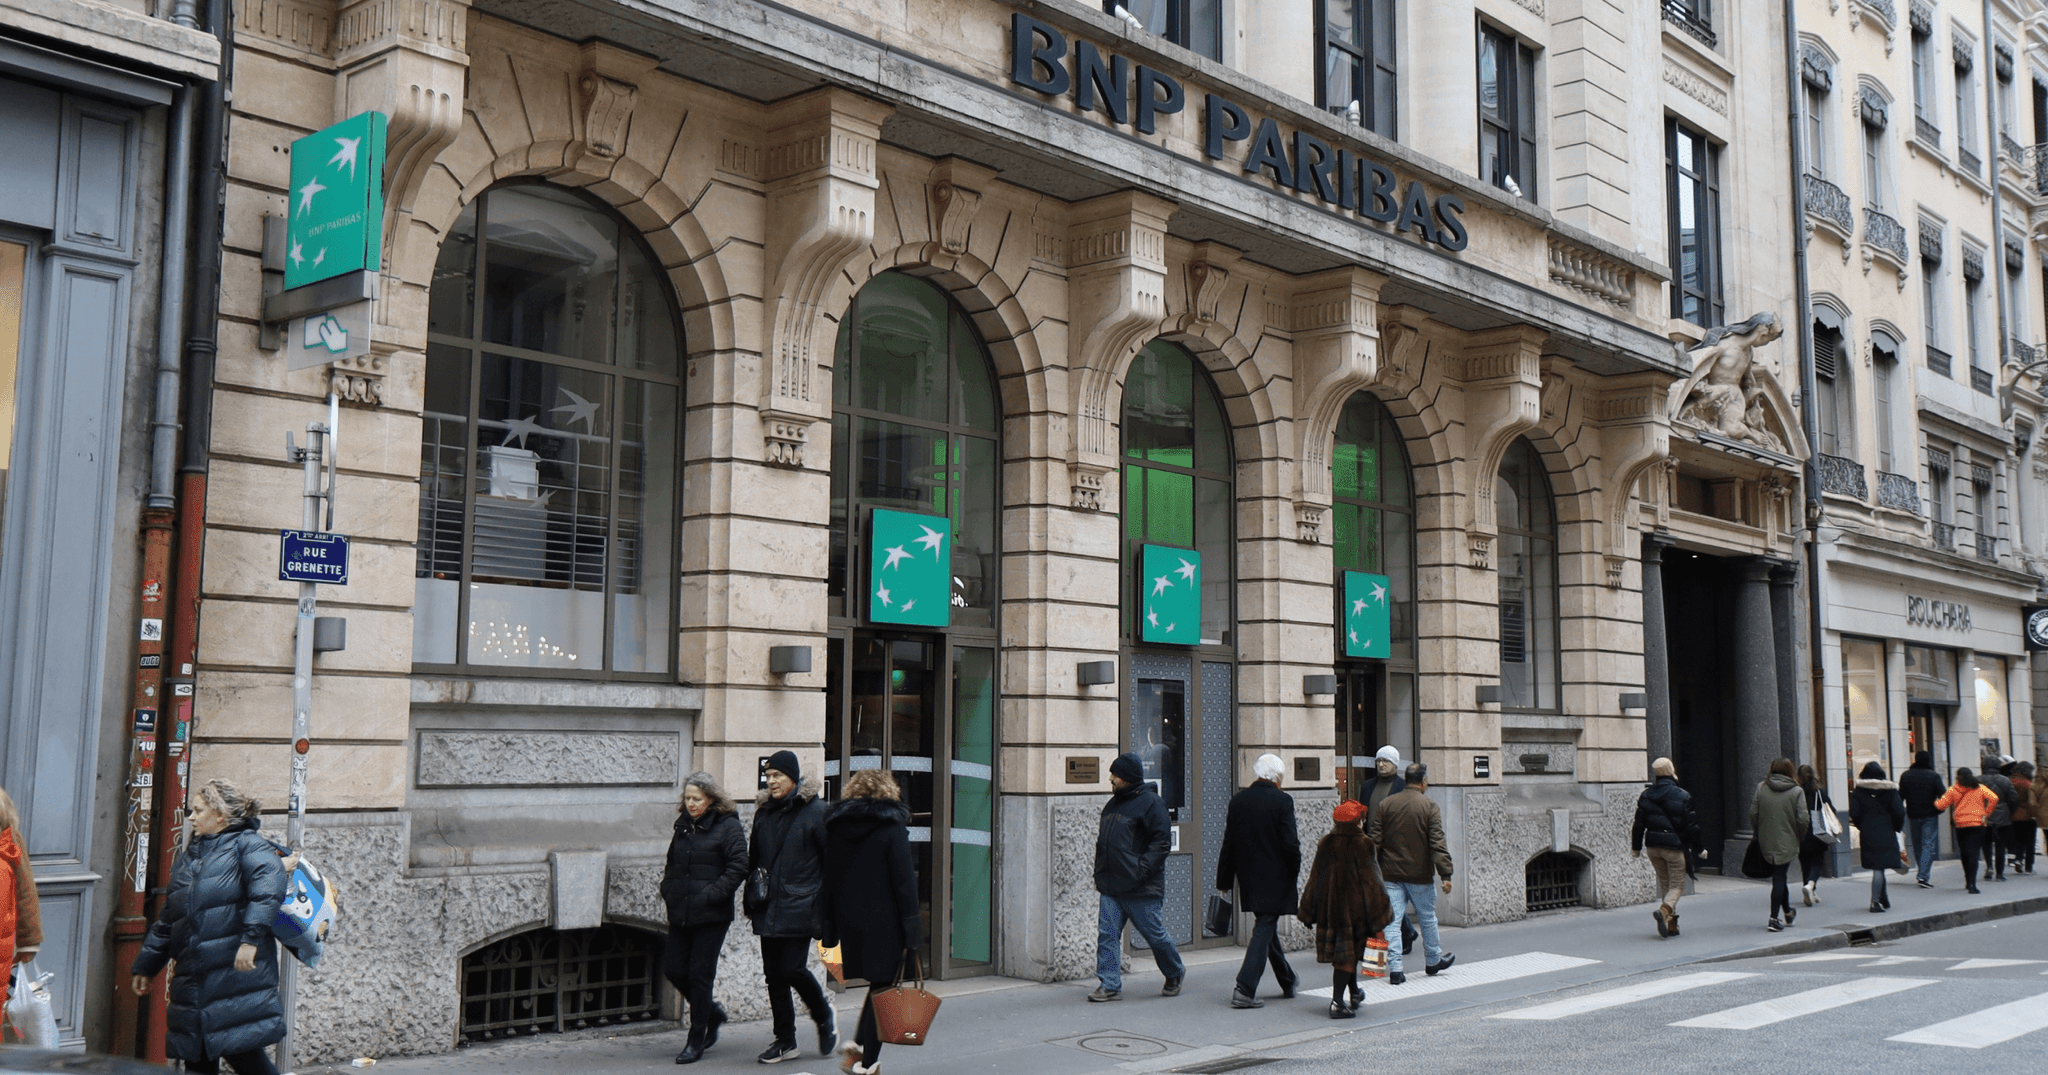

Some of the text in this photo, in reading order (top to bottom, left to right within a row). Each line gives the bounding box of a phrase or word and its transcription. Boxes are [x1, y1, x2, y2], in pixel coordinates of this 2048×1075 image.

[1011, 12, 1469, 252] BNP PARIBAS
[309, 211, 362, 237] BNP PARIBAS
[303, 546, 327, 558] RUE
[287, 561, 342, 575] GRENETTE
[1906, 595, 1972, 630] BOUCHARA
